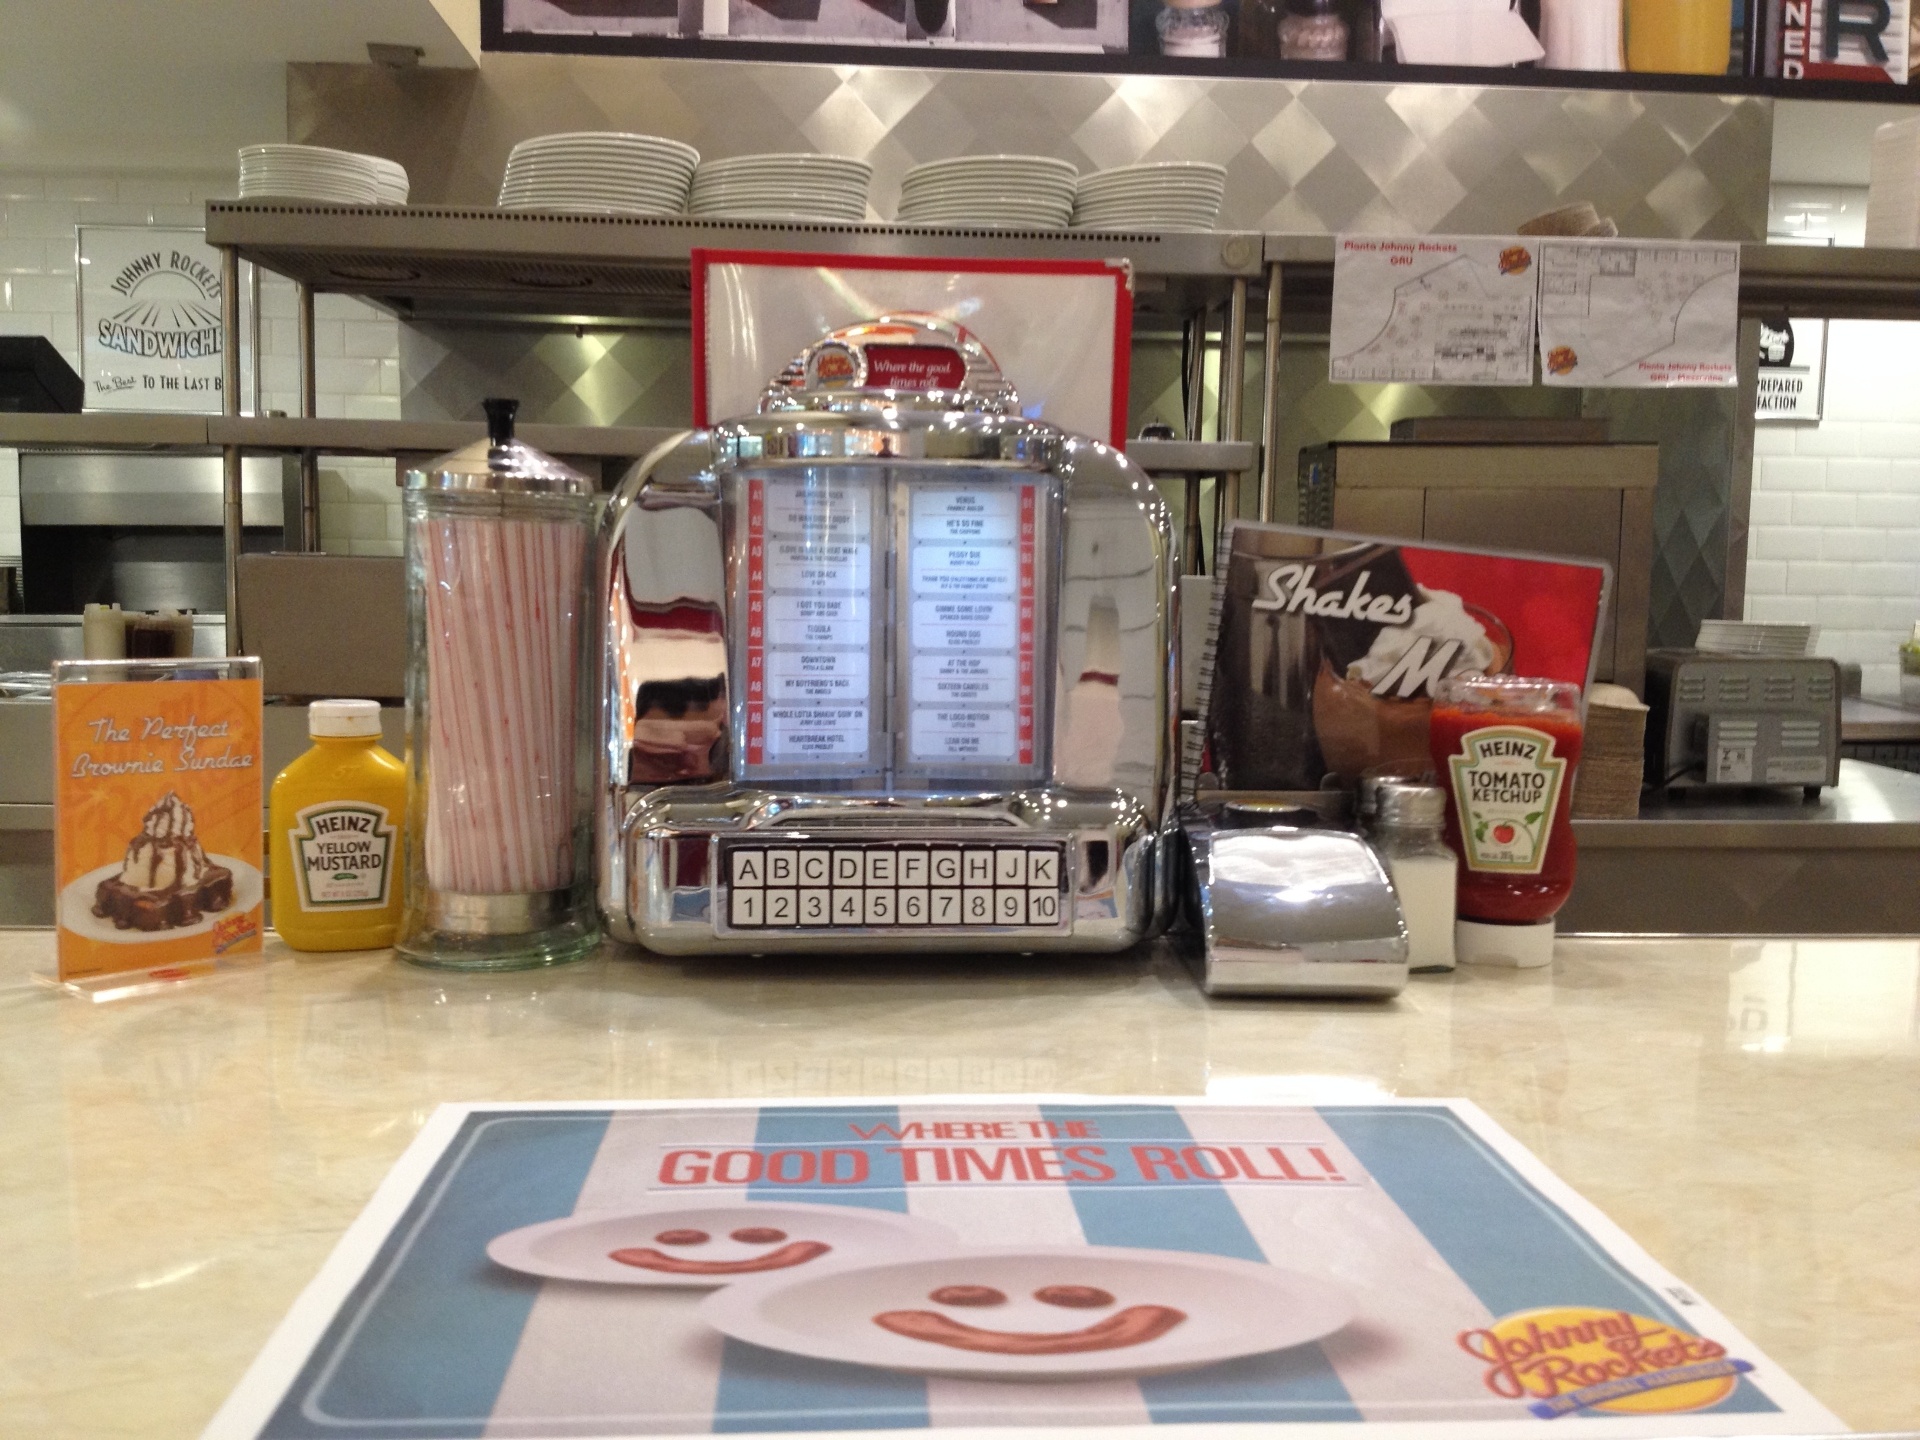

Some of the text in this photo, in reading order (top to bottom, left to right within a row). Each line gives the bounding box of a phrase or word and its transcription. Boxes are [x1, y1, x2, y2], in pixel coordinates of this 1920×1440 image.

[1380, 241, 1414, 254] Johnny
[1418, 242, 1457, 252] Rockets
[110, 250, 221, 299] JOHNNY ROCKETS
[873, 359, 951, 379] Where the good
[1668, 361, 1697, 373] Johnny
[93, 380, 111, 393] The
[142, 374, 156, 389] TO
[160, 374, 180, 390] THE
[184, 375, 210, 390] LAST
[1252, 563, 1412, 624] Shakes
[814, 601, 826, 610] YOU
[800, 656, 836, 664] DOWNTOWN
[772, 710, 793, 718] WHOLE
[88, 715, 229, 750] The Perfect
[788, 734, 826, 742] HEARTBREAK
[1479, 741, 1537, 760] HEINZ
[71, 745, 253, 778] Brownie Sundae
[1468, 770, 1546, 789] TOMATO
[1472, 788, 1542, 803] KETCHUP
[315, 815, 371, 835] HEINZ
[316, 841, 372, 854] YELLOW
[307, 854, 382, 871] MUSTARD
[739, 858, 1051, 880] A B C D E F G H J K
[743, 897, 1056, 918] 1 2 3 4 5 6 7 8 9 10
[848, 1120, 1102, 1140] WHERE THE
[658, 1146, 1347, 1185] GOOD TIMES ROLL!
[1456, 1311, 1667, 1399] Johnny
[1521, 1334, 1727, 1400] Rockets
